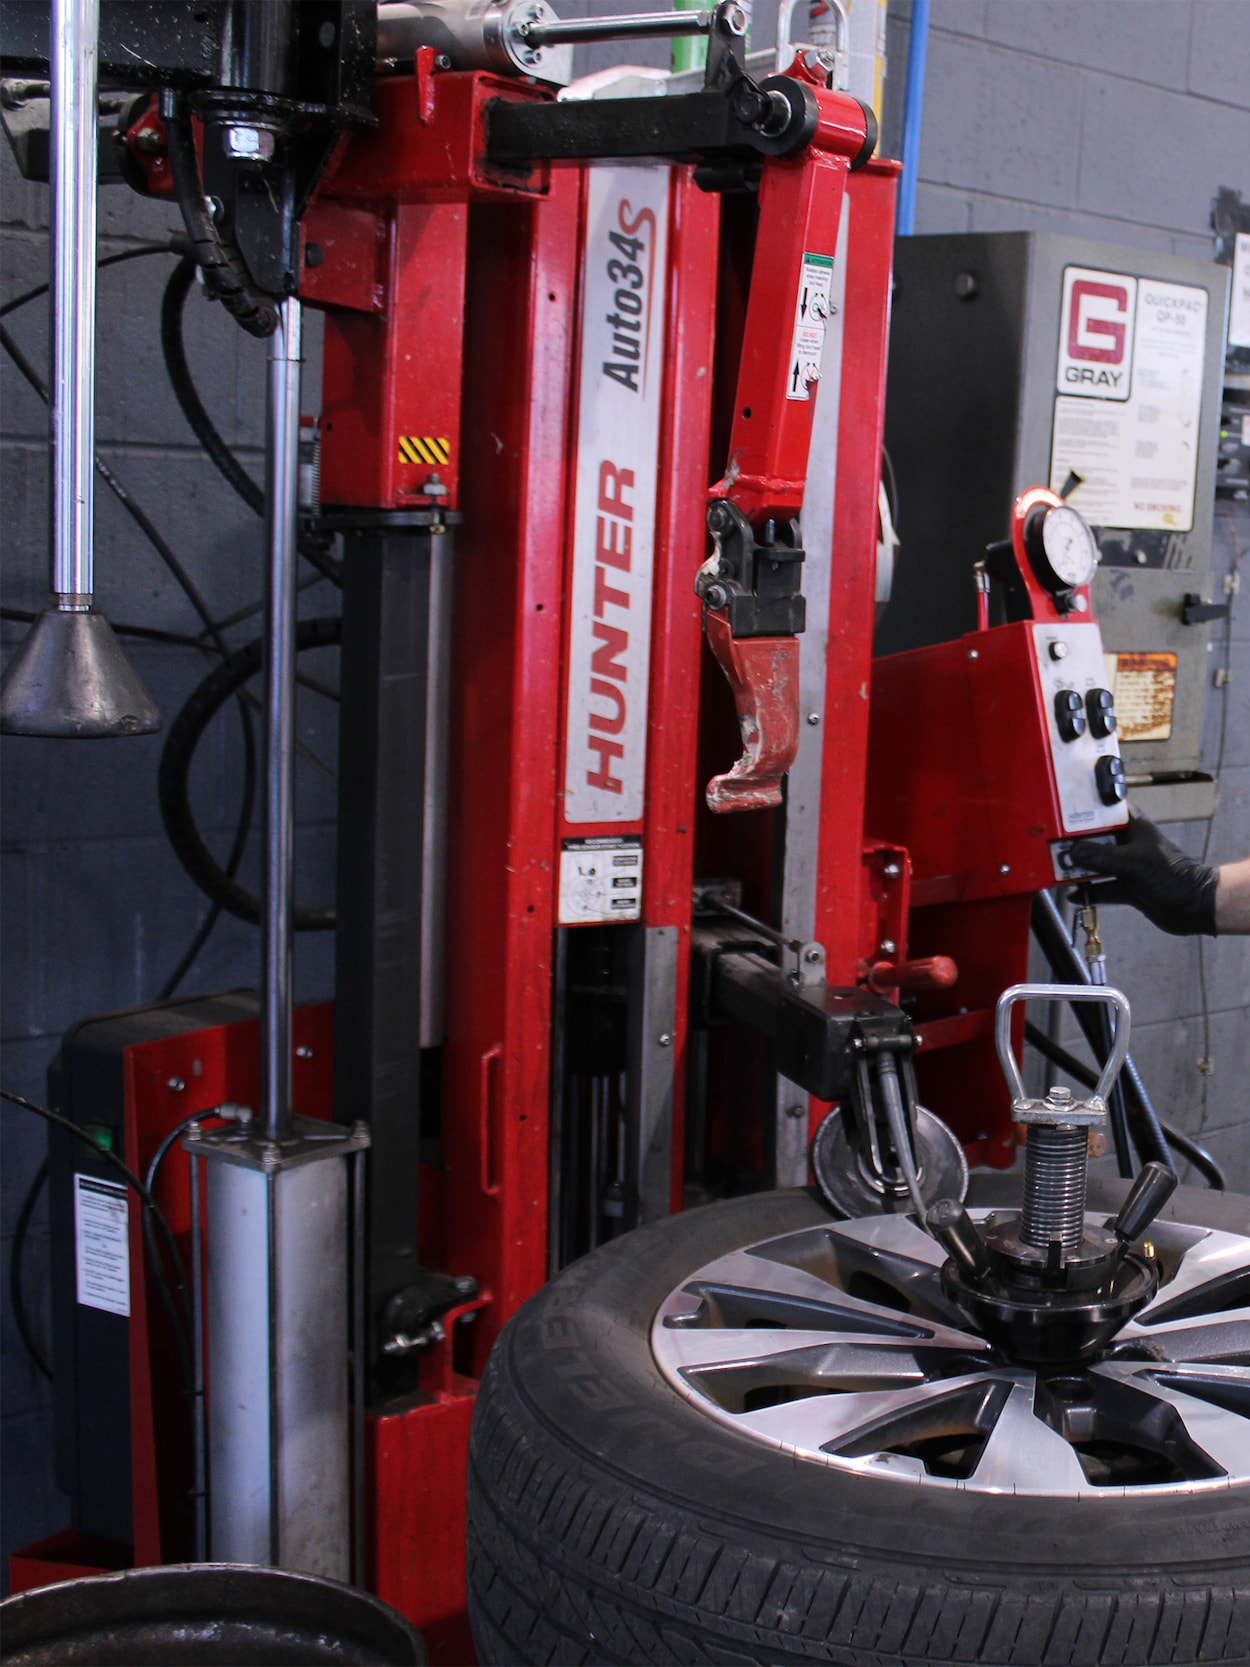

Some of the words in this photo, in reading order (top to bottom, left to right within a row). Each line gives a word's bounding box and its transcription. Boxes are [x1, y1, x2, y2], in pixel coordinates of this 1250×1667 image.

[602, 198, 656, 397] Auto34S
[1065, 367, 1123, 388] GRAY
[586, 459, 635, 795] HUNTER
